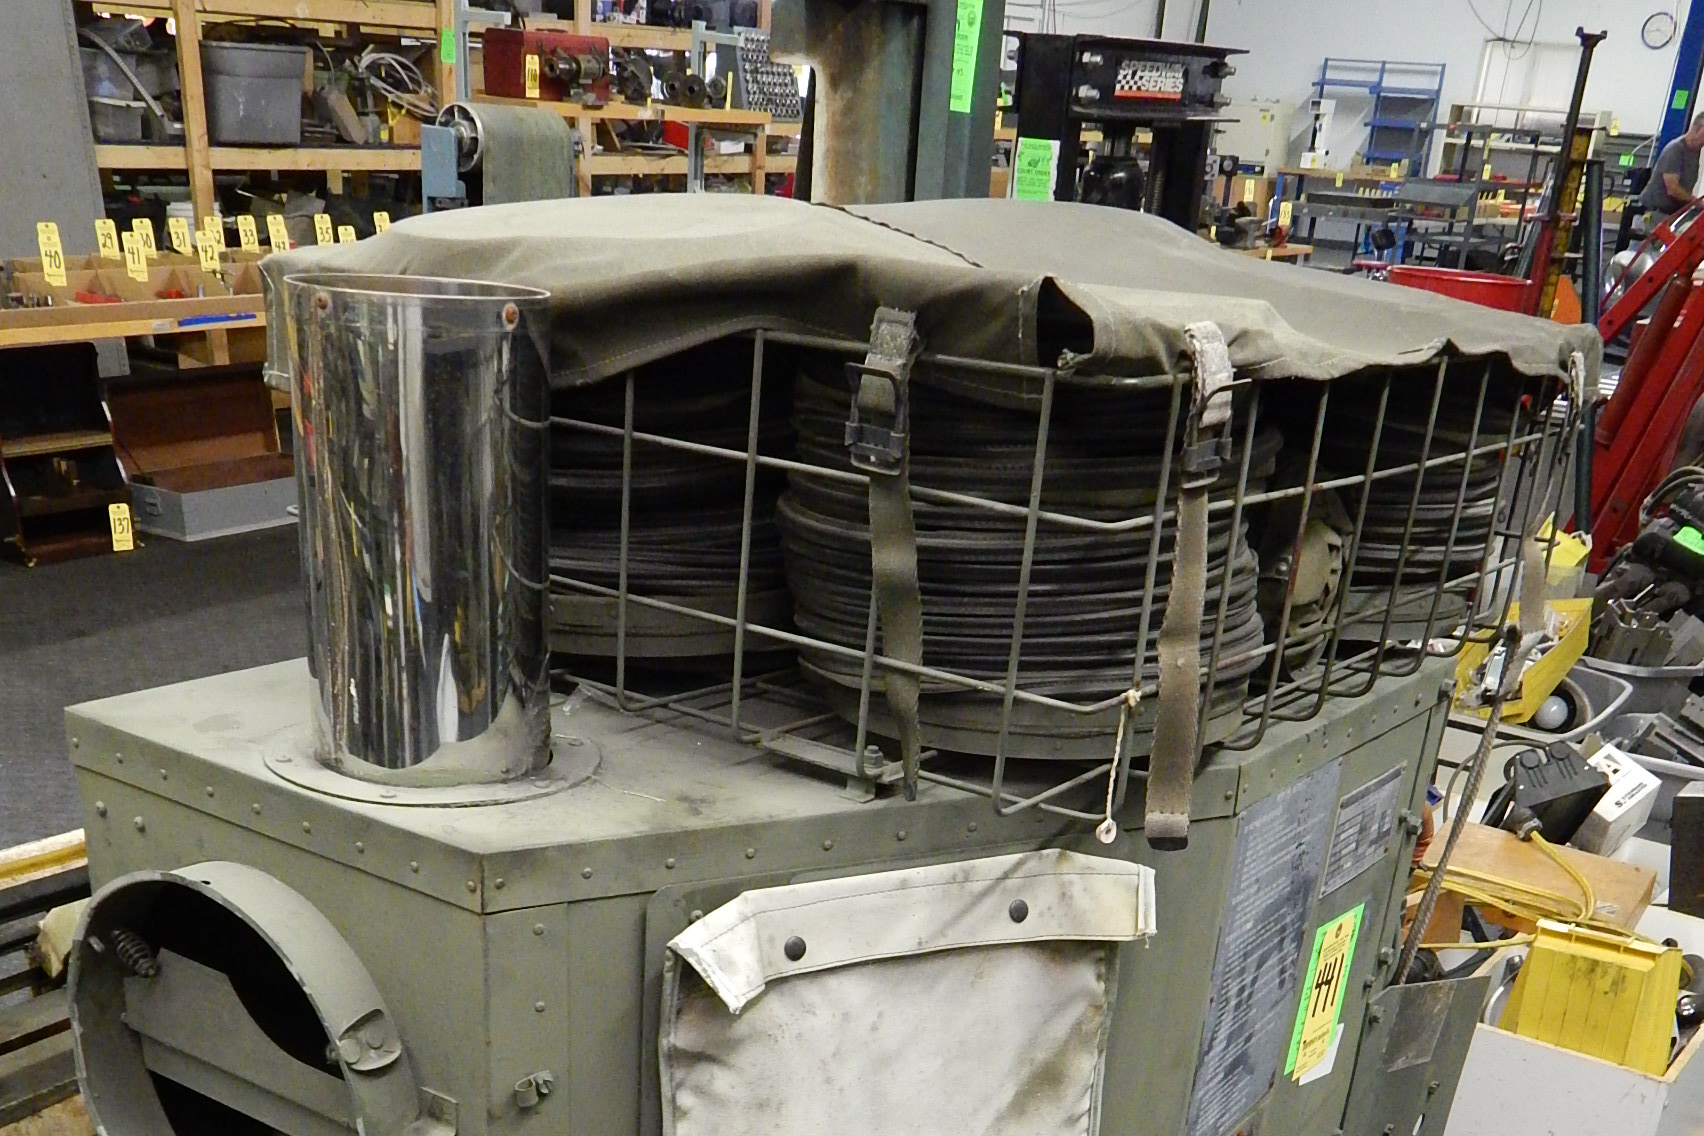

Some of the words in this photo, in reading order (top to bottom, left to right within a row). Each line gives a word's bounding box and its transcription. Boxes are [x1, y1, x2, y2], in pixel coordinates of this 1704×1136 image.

[1121, 60, 1187, 79] SPEEDWAY
[1141, 76, 1184, 93] SERIES
[101, 232, 114, 250] 29
[174, 231, 186, 248] 31
[242, 229, 256, 245] 33
[318, 226, 331, 243] 35
[44, 249, 62, 270] 40
[127, 246, 141, 265] 41
[201, 244, 217, 263] 42
[112, 517, 130, 535] 137
[1311, 952, 1345, 1018] 441
